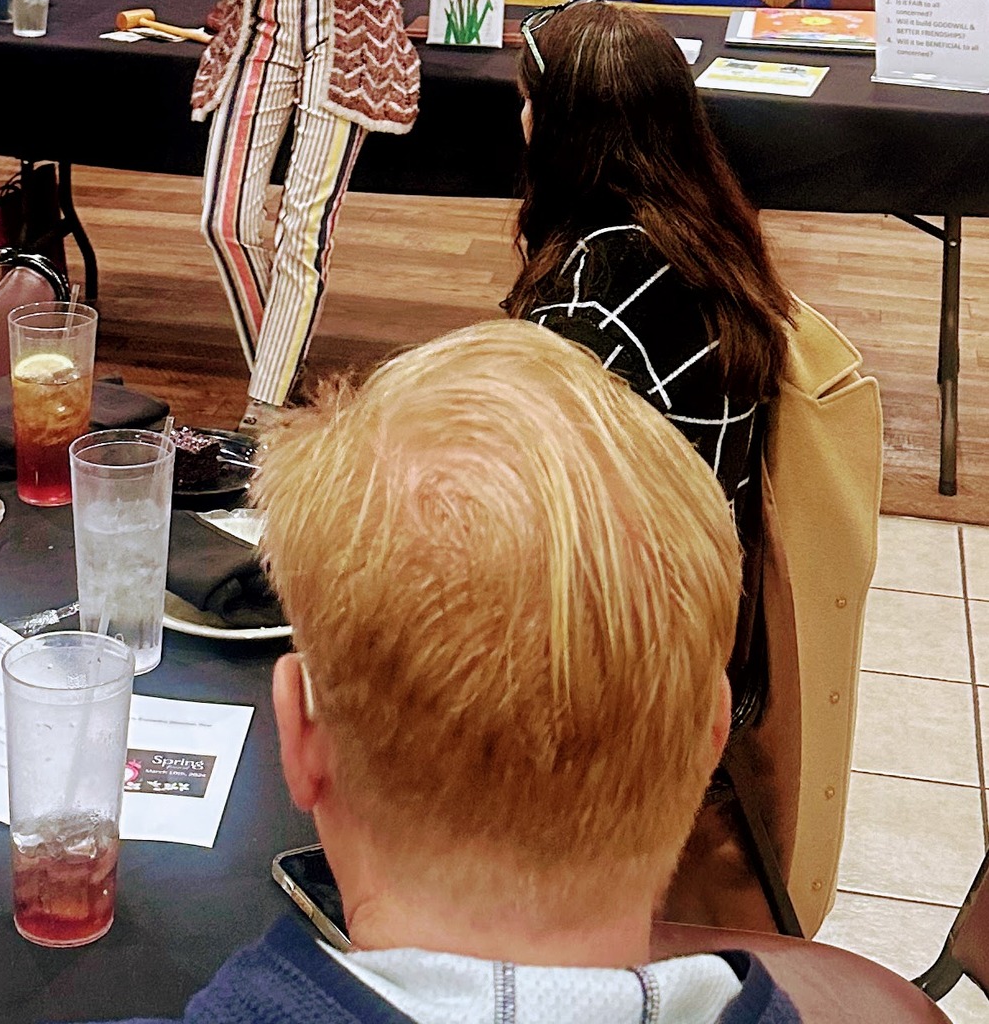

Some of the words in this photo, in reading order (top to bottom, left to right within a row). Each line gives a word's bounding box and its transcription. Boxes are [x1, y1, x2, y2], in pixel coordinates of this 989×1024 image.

[933, 21, 968, 30] GOODWILL
[921, 30, 965, 39] FRIENDSHIPS?
[926, 41, 961, 50] BENEFICIAL
[897, 49, 933, 57] concerned?
[152, 754, 204, 770] Spring
